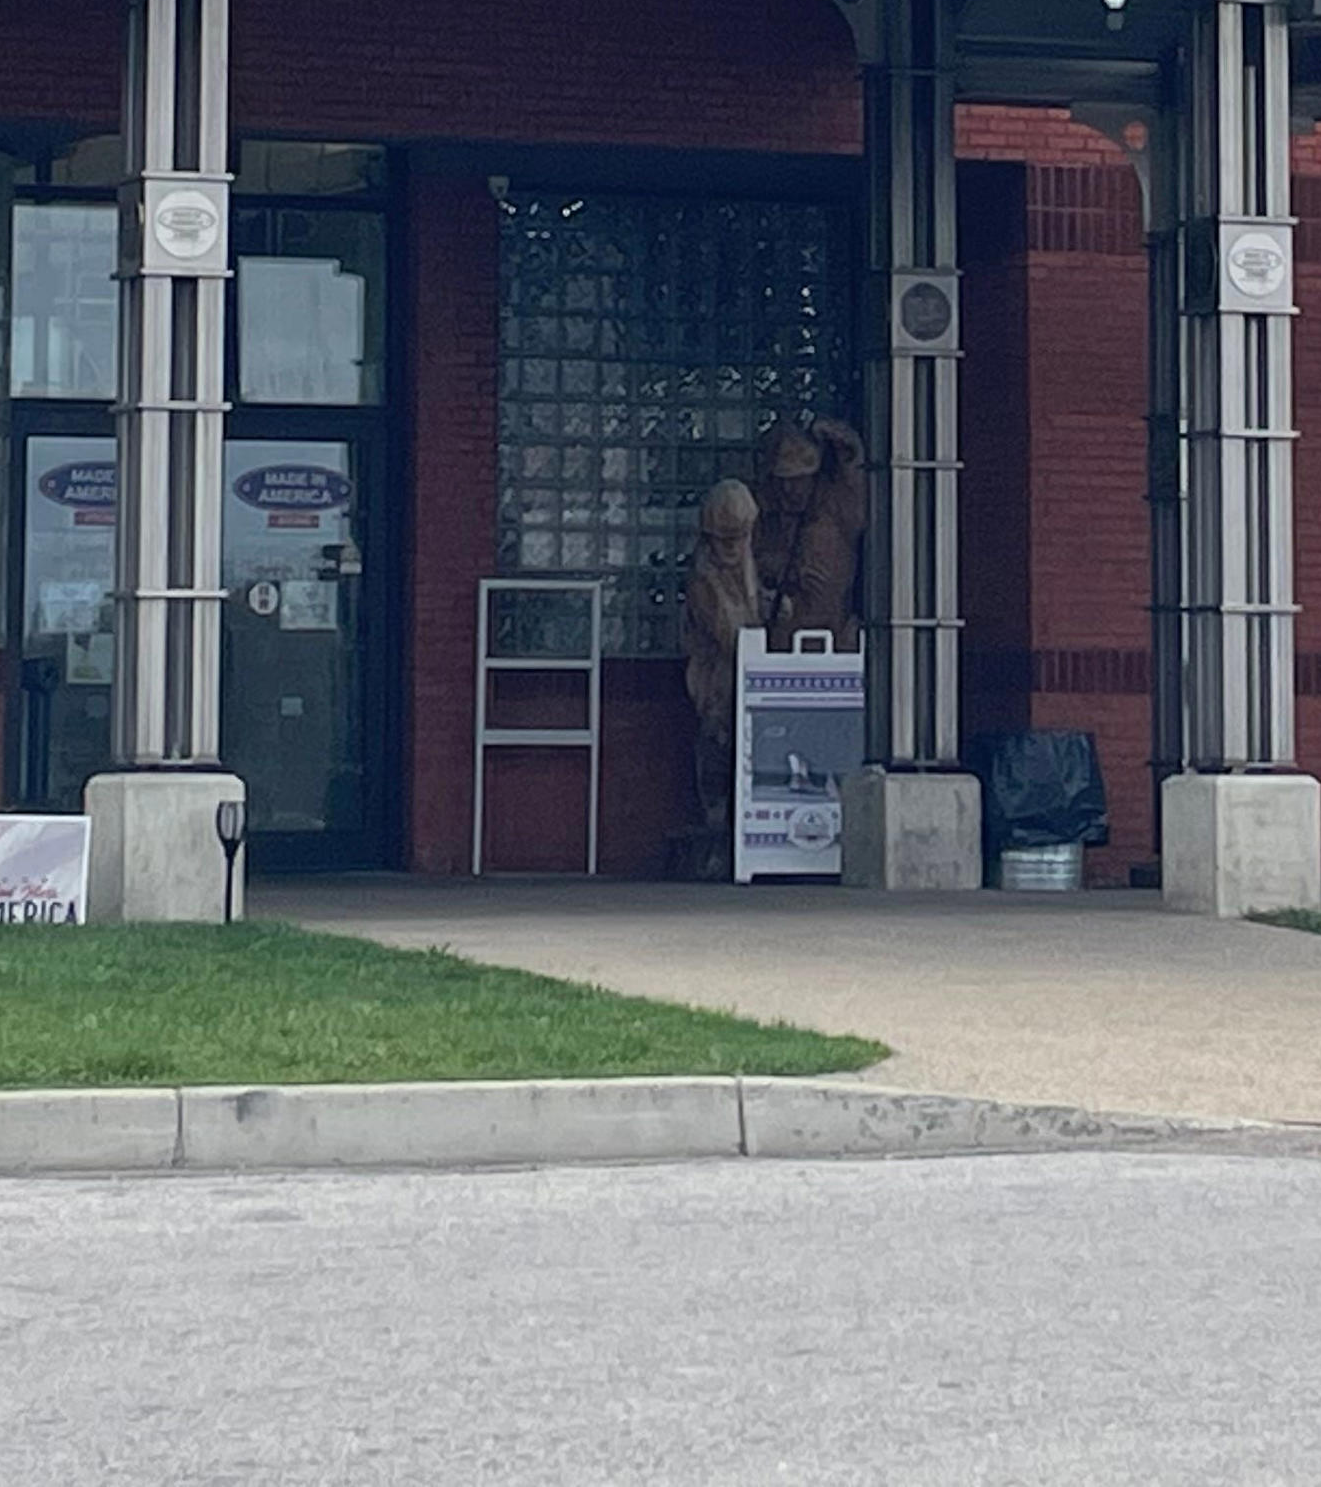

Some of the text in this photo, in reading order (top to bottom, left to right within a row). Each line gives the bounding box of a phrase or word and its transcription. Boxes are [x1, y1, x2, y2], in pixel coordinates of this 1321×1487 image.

[71, 469, 115, 483] MADE
[264, 472, 308, 486] MADE
[258, 489, 333, 504] AMERICA
